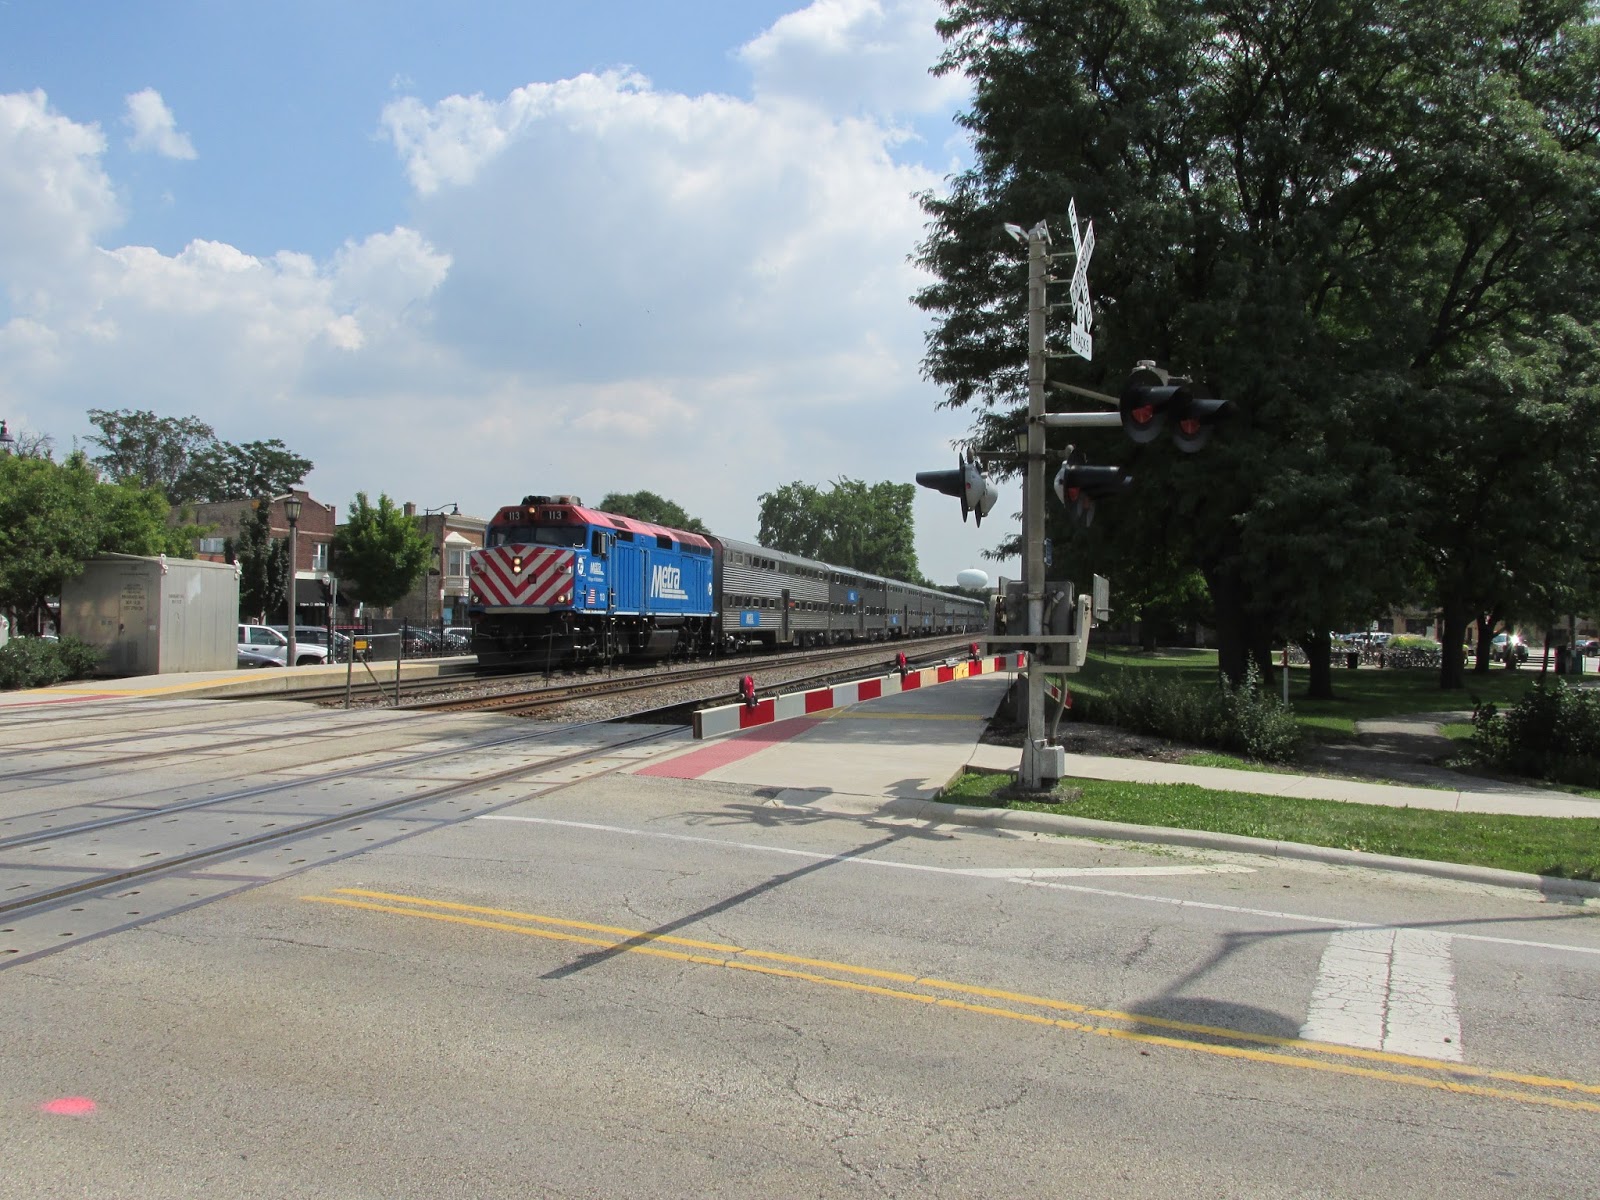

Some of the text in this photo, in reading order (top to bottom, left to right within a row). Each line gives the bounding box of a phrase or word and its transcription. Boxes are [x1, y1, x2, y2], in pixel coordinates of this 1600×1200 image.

[1073, 330, 1090, 353] TRACKS
[509, 511, 520, 521] 113
[549, 510, 562, 520] 113
[650, 563, 681, 598] Metra
